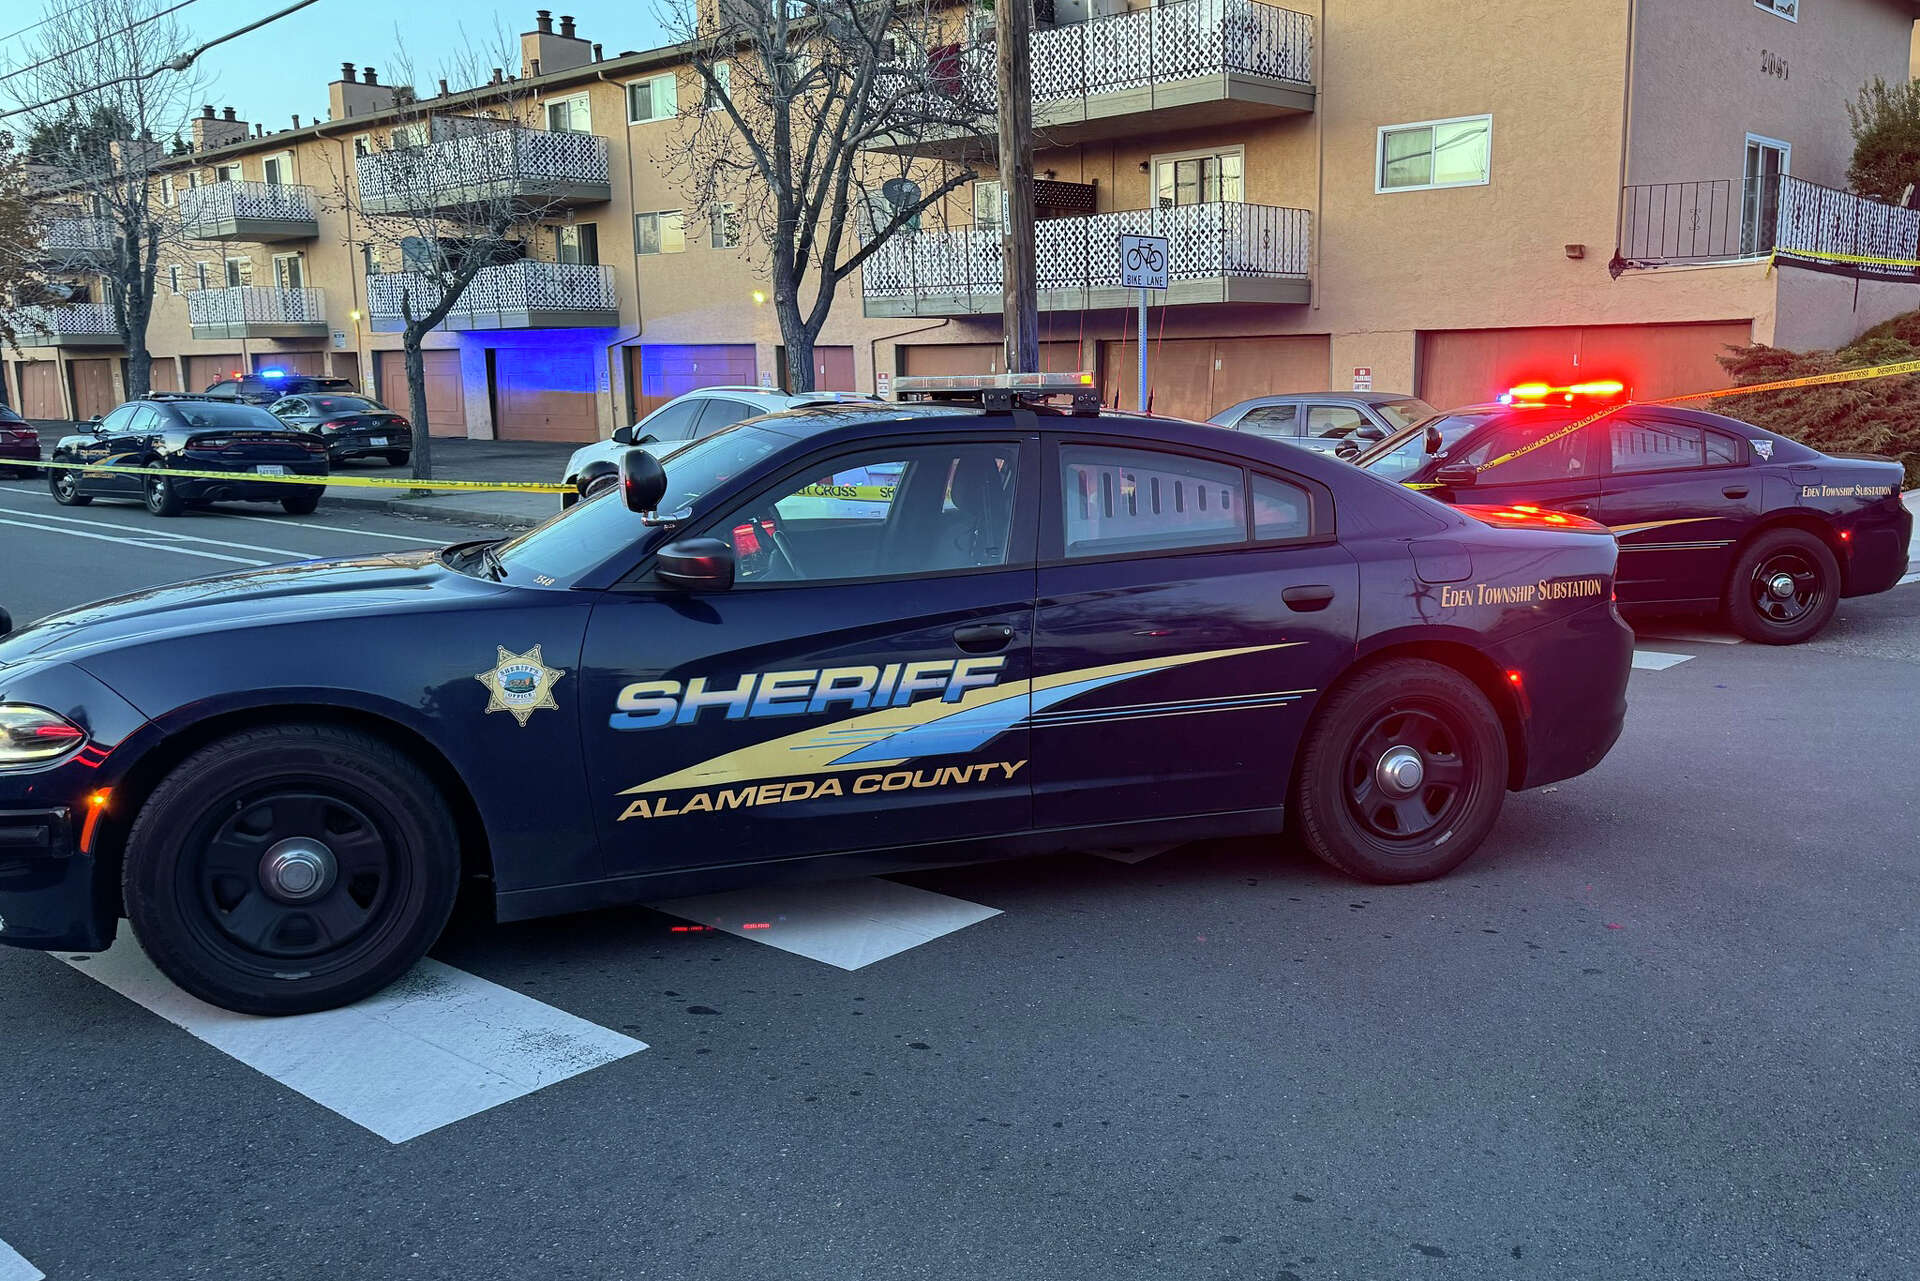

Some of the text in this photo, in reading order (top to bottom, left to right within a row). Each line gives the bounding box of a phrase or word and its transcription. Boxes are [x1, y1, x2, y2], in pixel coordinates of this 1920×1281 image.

[1127, 275, 1163, 286] BIKE LANE
[815, 485, 857, 497] CROSS
[1441, 579, 1602, 608] EDEN TOWNSHIP SUBSTATION
[608, 656, 1007, 731] SHERIFF
[616, 759, 1029, 822] ALAMEDA COUNTY
